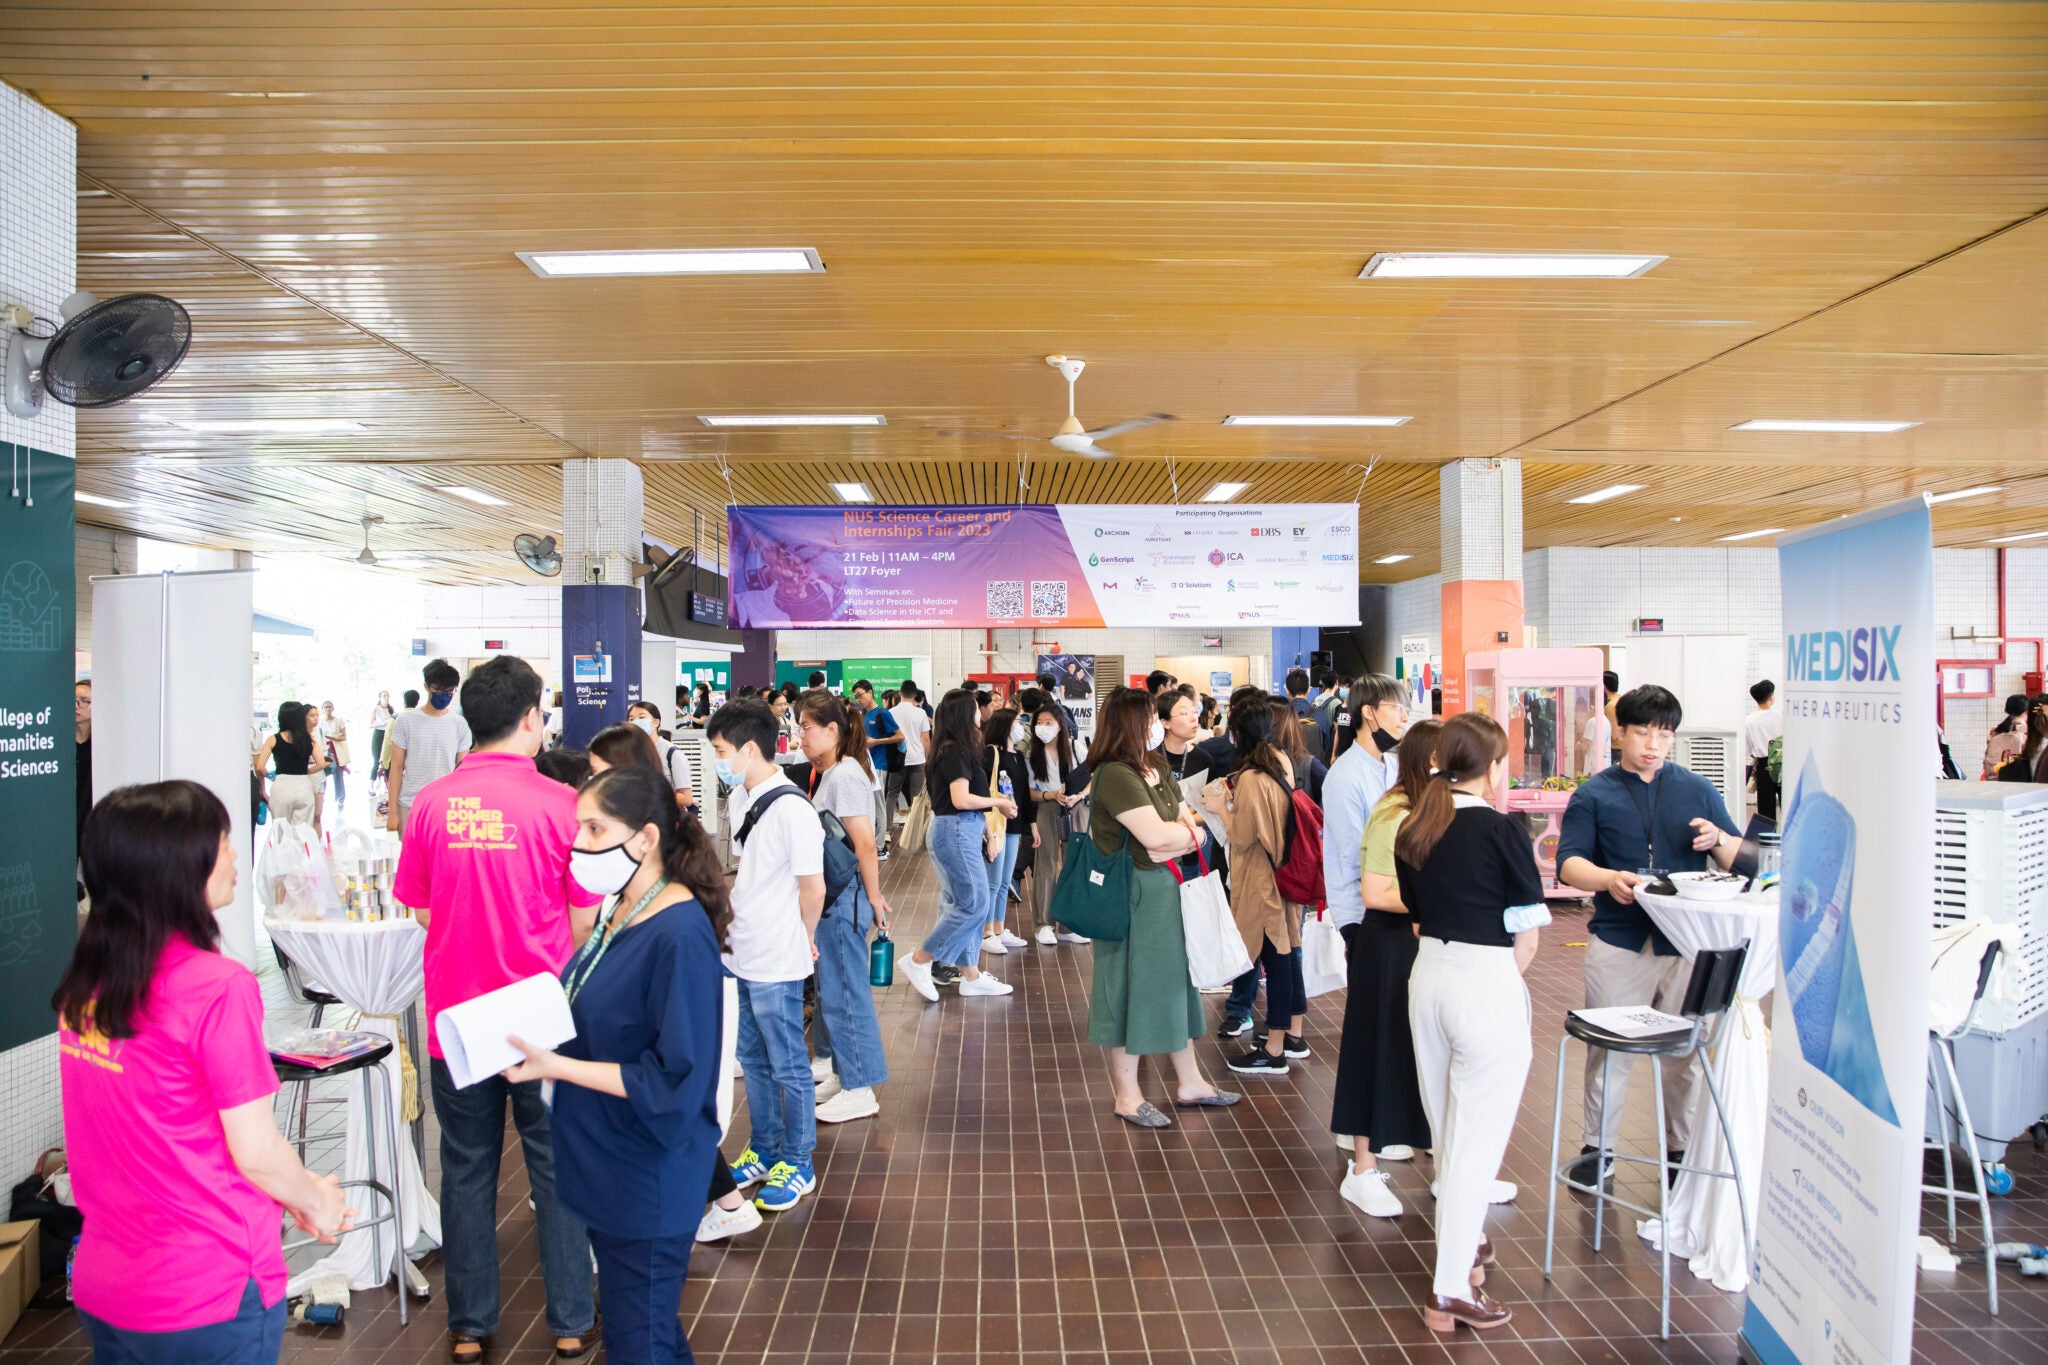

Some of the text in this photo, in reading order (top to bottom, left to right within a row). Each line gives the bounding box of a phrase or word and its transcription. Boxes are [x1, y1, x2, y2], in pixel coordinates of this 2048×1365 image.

[844, 509, 1011, 523] NUS Science Career and
[1175, 509, 1262, 518] Participating Organisations
[844, 525, 991, 539] Internships Fair 2023
[1260, 528, 1281, 536] DBS
[1293, 528, 1305, 536] EY
[844, 552, 856, 562] 21
[860, 552, 879, 562] Feb
[889, 552, 919, 562] 11AM
[932, 552, 955, 562] 4PM
[1100, 556, 1134, 564] GenScript
[1227, 552, 1244, 561] ICA
[844, 566, 901, 578] LT27 Foyer
[844, 588, 863, 596] With
[865, 588, 900, 596] Seminars
[876, 598, 884, 606] of
[886, 598, 921, 606] Precision
[923, 598, 958, 606] Medicine
[848, 608, 867, 616] Data
[869, 608, 898, 616] Science
[900, 608, 907, 616] in
[909, 608, 922, 616] the
[1786, 624, 1902, 683] MEDISIX
[36, 706, 52, 725] of
[1786, 699, 1902, 724] THERAPEUTICS
[1, 758, 59, 779] Sciences
[448, 796, 482, 810] THE
[446, 809, 504, 823] POWER
[446, 821, 505, 842] OF WE
